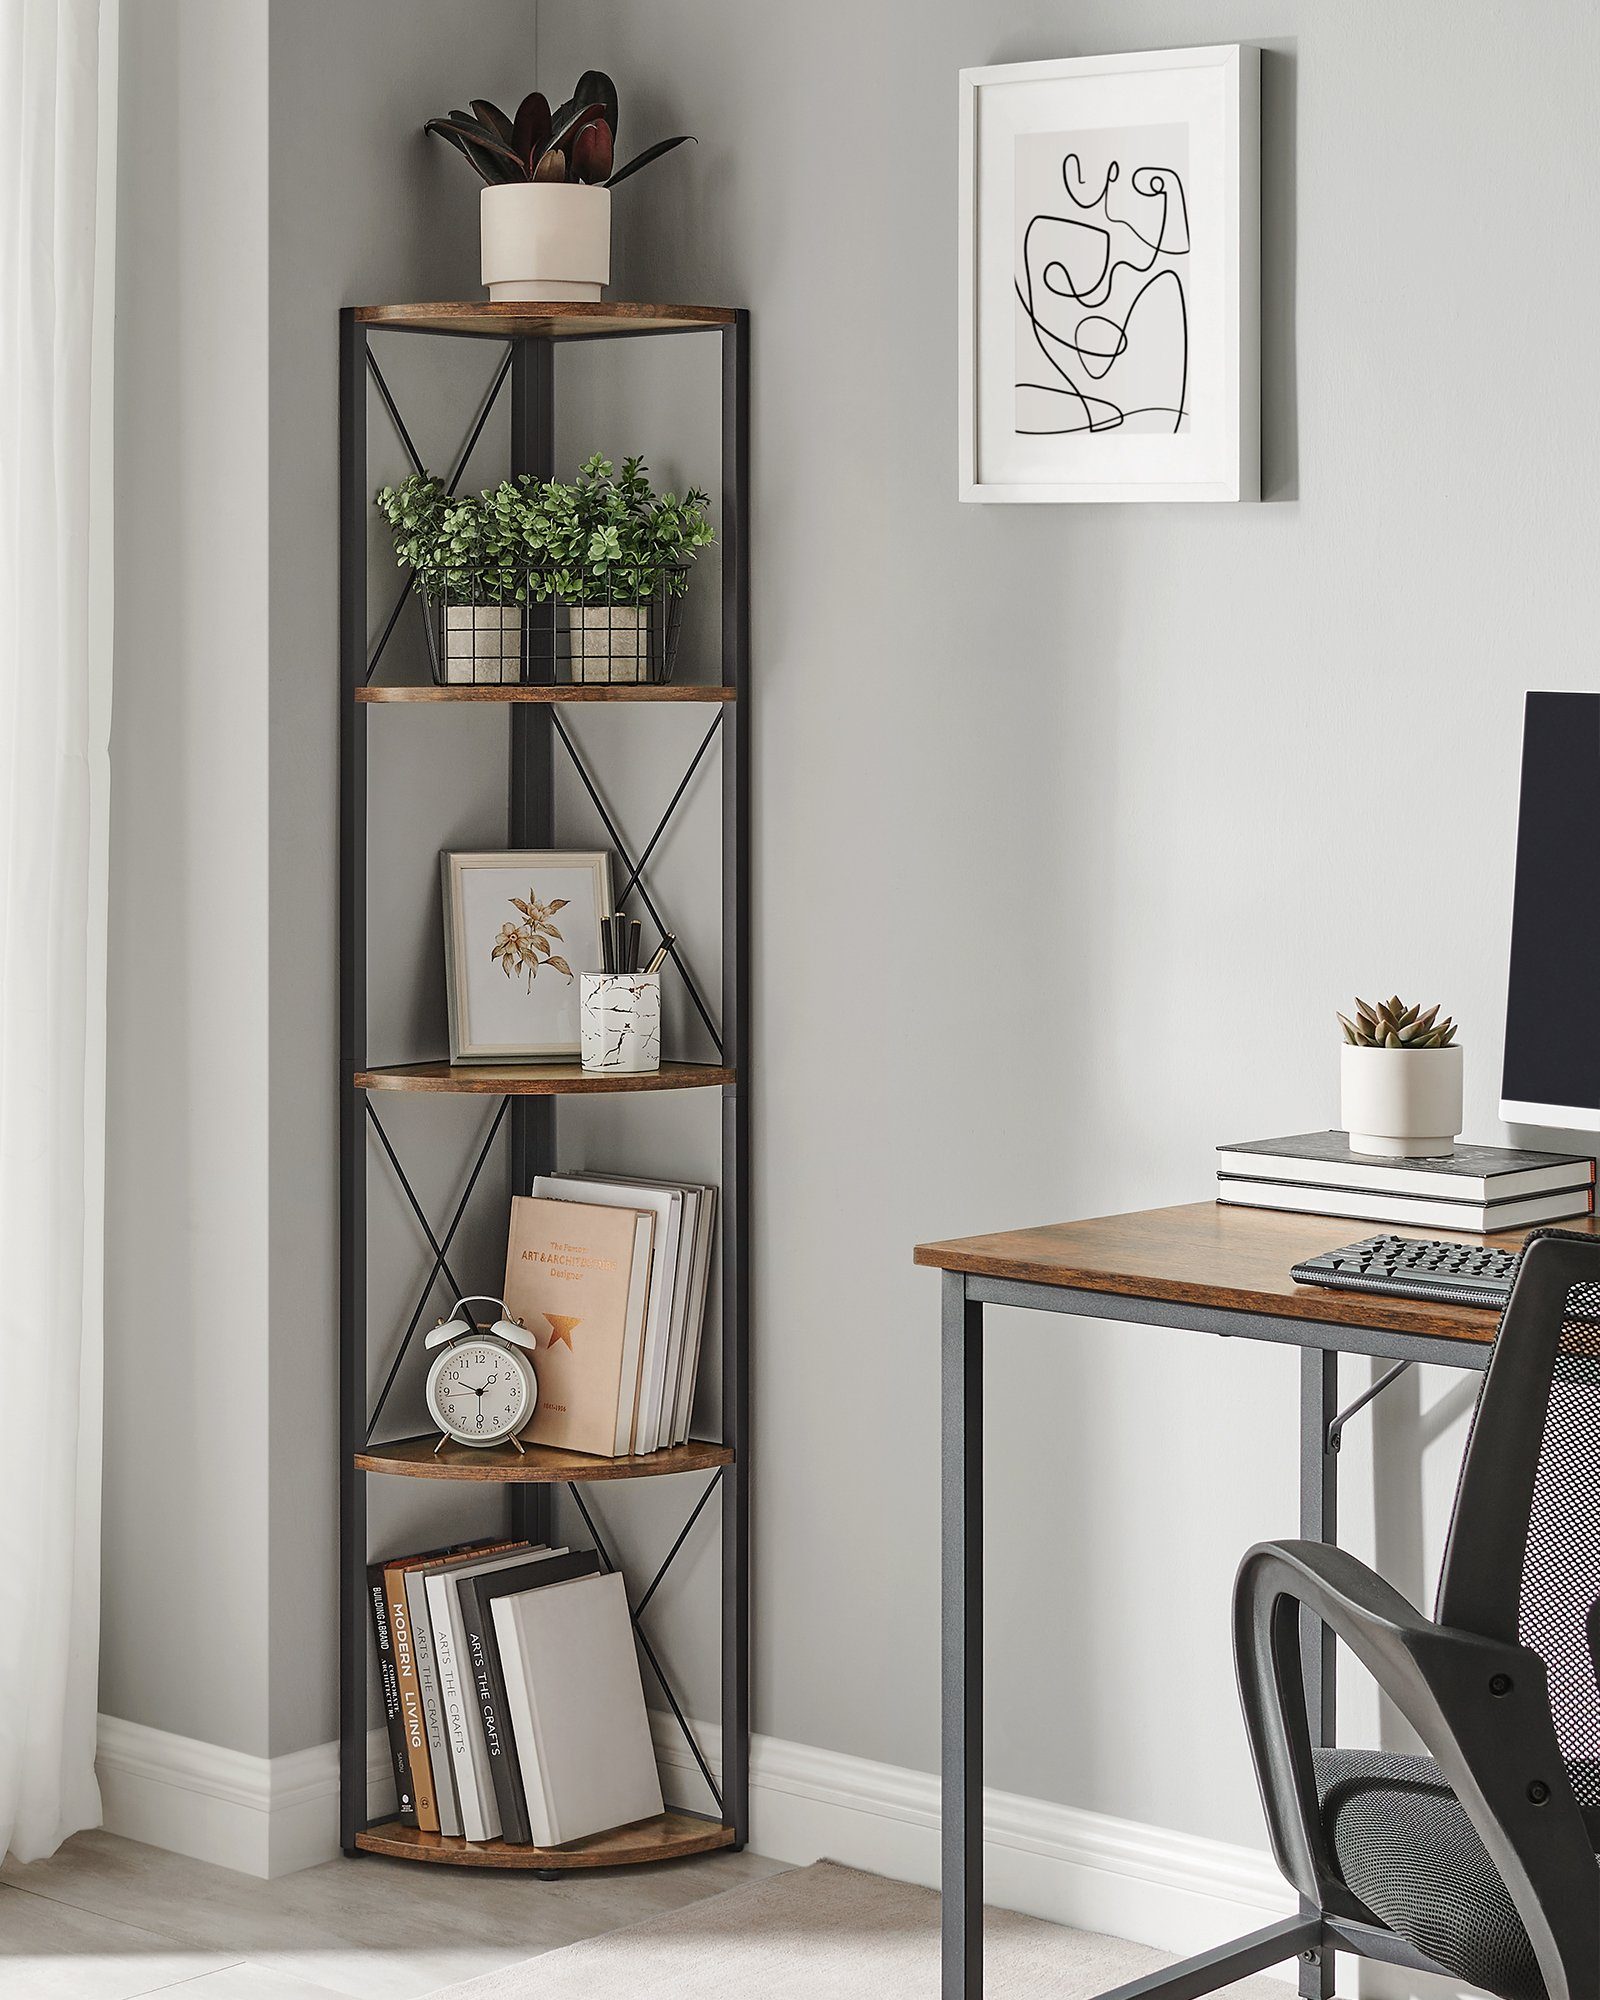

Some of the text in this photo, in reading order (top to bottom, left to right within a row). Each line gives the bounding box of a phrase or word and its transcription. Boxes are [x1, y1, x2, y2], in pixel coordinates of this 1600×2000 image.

[550, 1241, 562, 1251] The
[521, 1250, 538, 1261] ART
[540, 1252, 547, 1262] &
[475, 1355, 485, 1363] 12
[460, 1360, 469, 1368] 11
[494, 1360, 498, 1368] 1
[448, 1371, 459, 1380] 10
[505, 1372, 511, 1380] 2
[443, 1387, 450, 1396] 9
[510, 1388, 516, 1396] 3
[448, 1404, 455, 1413] 8
[505, 1404, 511, 1413] 4
[461, 1416, 467, 1425] 7
[493, 1416, 499, 1425] 5
[373, 1587, 384, 1620] BUILDING
[378, 1626, 389, 1650] BRAND
[393, 1603, 421, 1748] MODERN LIVING
[381, 1658, 394, 1720] ARCHITECTURE
[388, 1664, 399, 1713] CORPORATE
[417, 1627, 441, 1748] ARTS THE CRAFTS
[438, 1631, 466, 1754] ARTS THE CRAFTS
[469, 1633, 500, 1756] ARTS THE CRAFTS
